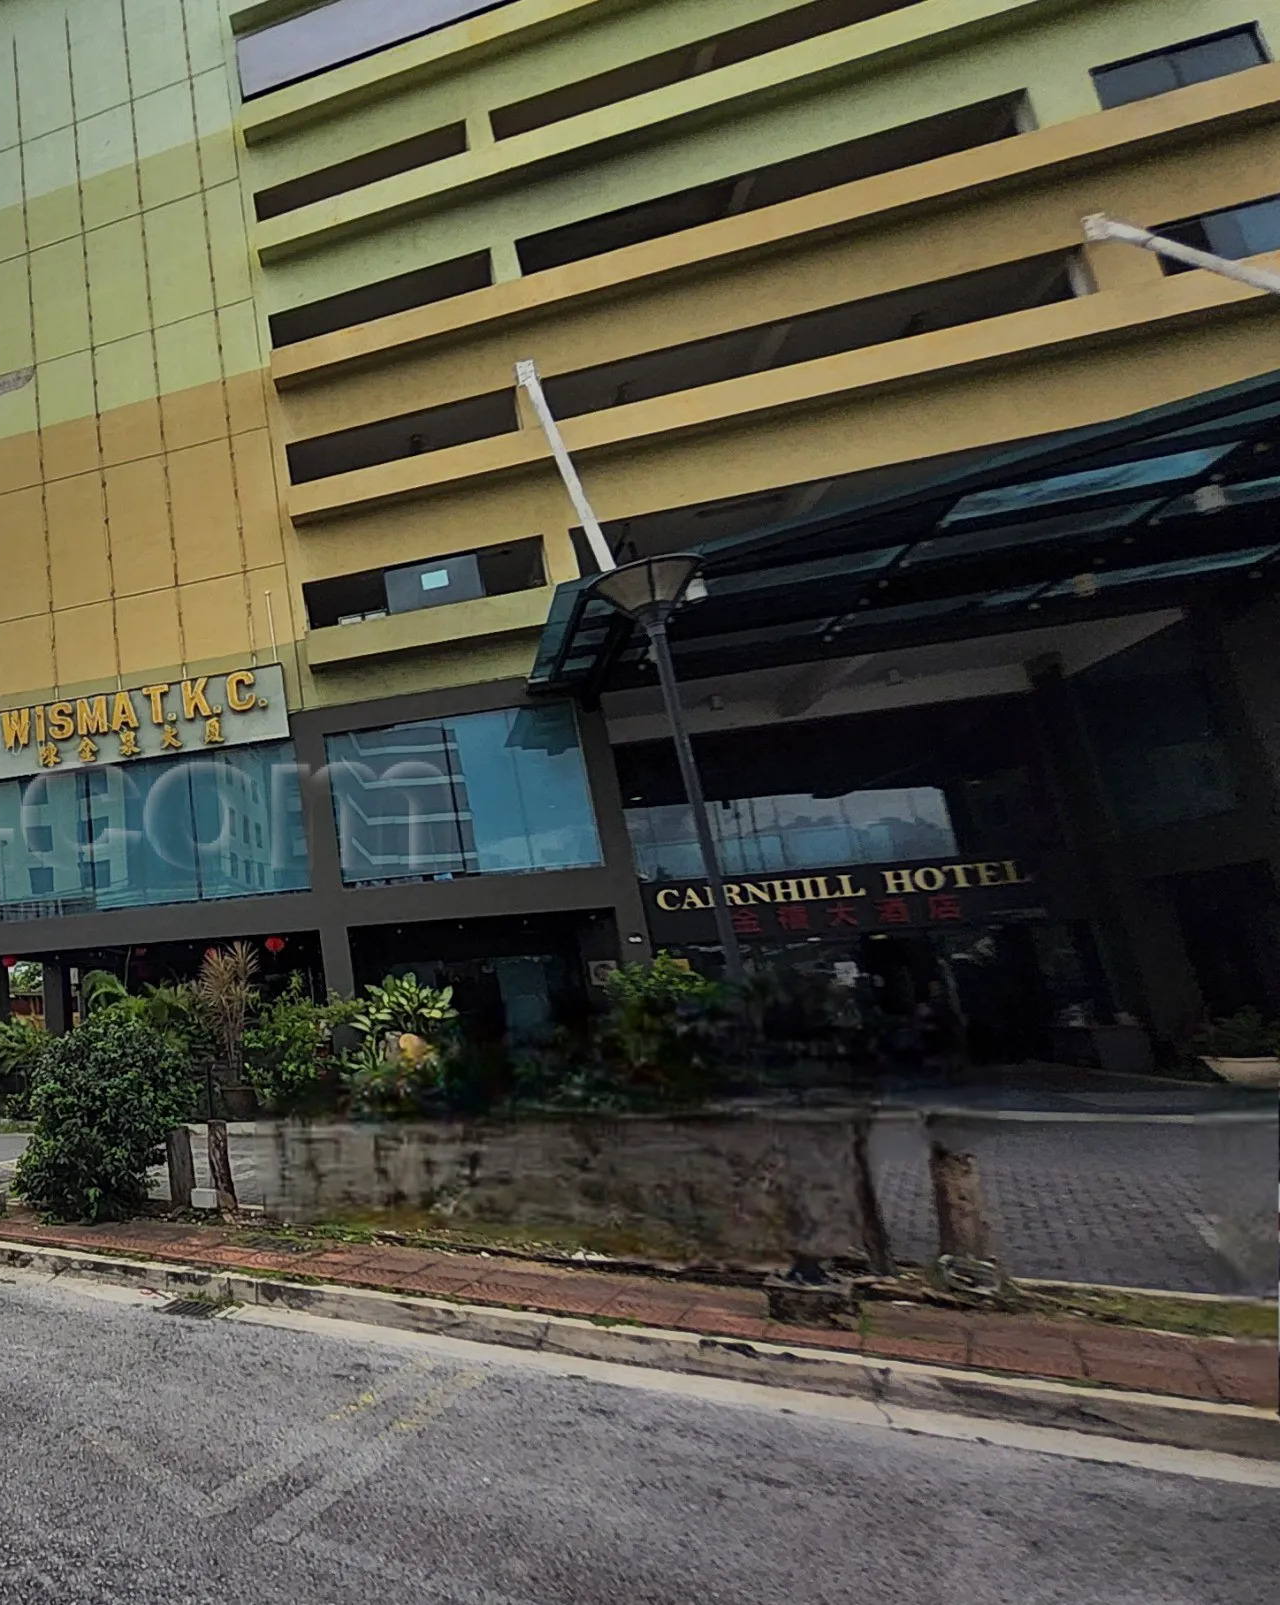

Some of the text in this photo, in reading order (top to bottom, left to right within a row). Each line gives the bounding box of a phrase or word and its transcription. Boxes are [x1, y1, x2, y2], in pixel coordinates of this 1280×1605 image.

[0, 691, 140, 750] WISMA
[656, 860, 1029, 911] CAIRNHILL HOTEL
